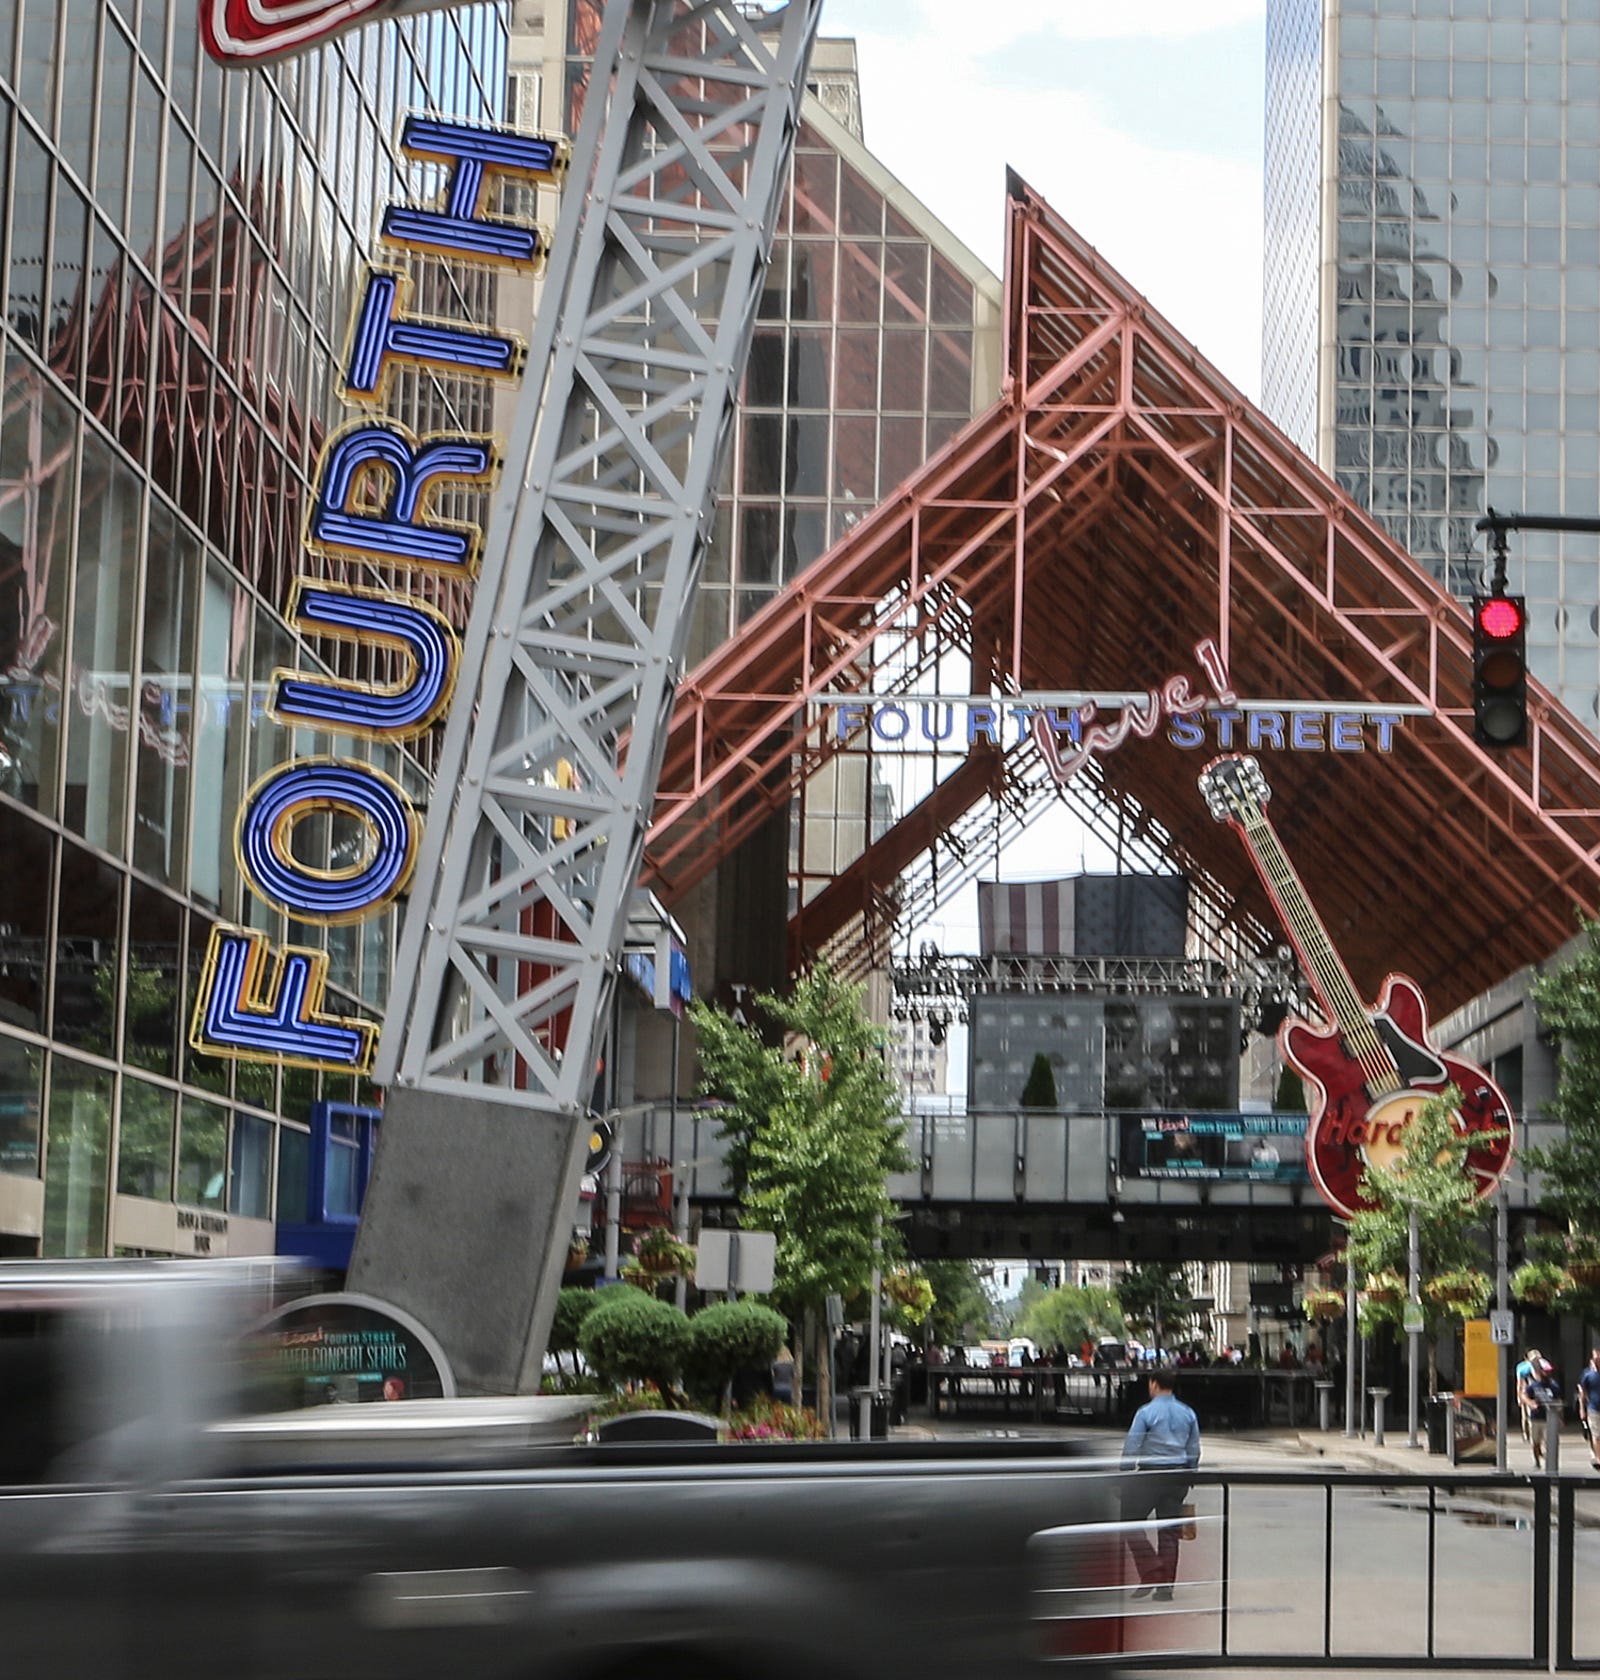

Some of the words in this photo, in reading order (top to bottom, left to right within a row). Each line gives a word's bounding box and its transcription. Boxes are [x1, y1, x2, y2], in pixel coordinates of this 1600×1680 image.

[189, 112, 572, 1076] FOURTH
[835, 703, 1083, 746] FOURTH
[1168, 710, 1404, 753] STREET
[1032, 638, 1240, 785] Live!
[312, 1345, 363, 1372] CONCERT
[367, 1342, 408, 1371] SERIES
[324, 1332, 360, 1345] FOURTH
[361, 1330, 397, 1344] STREET
